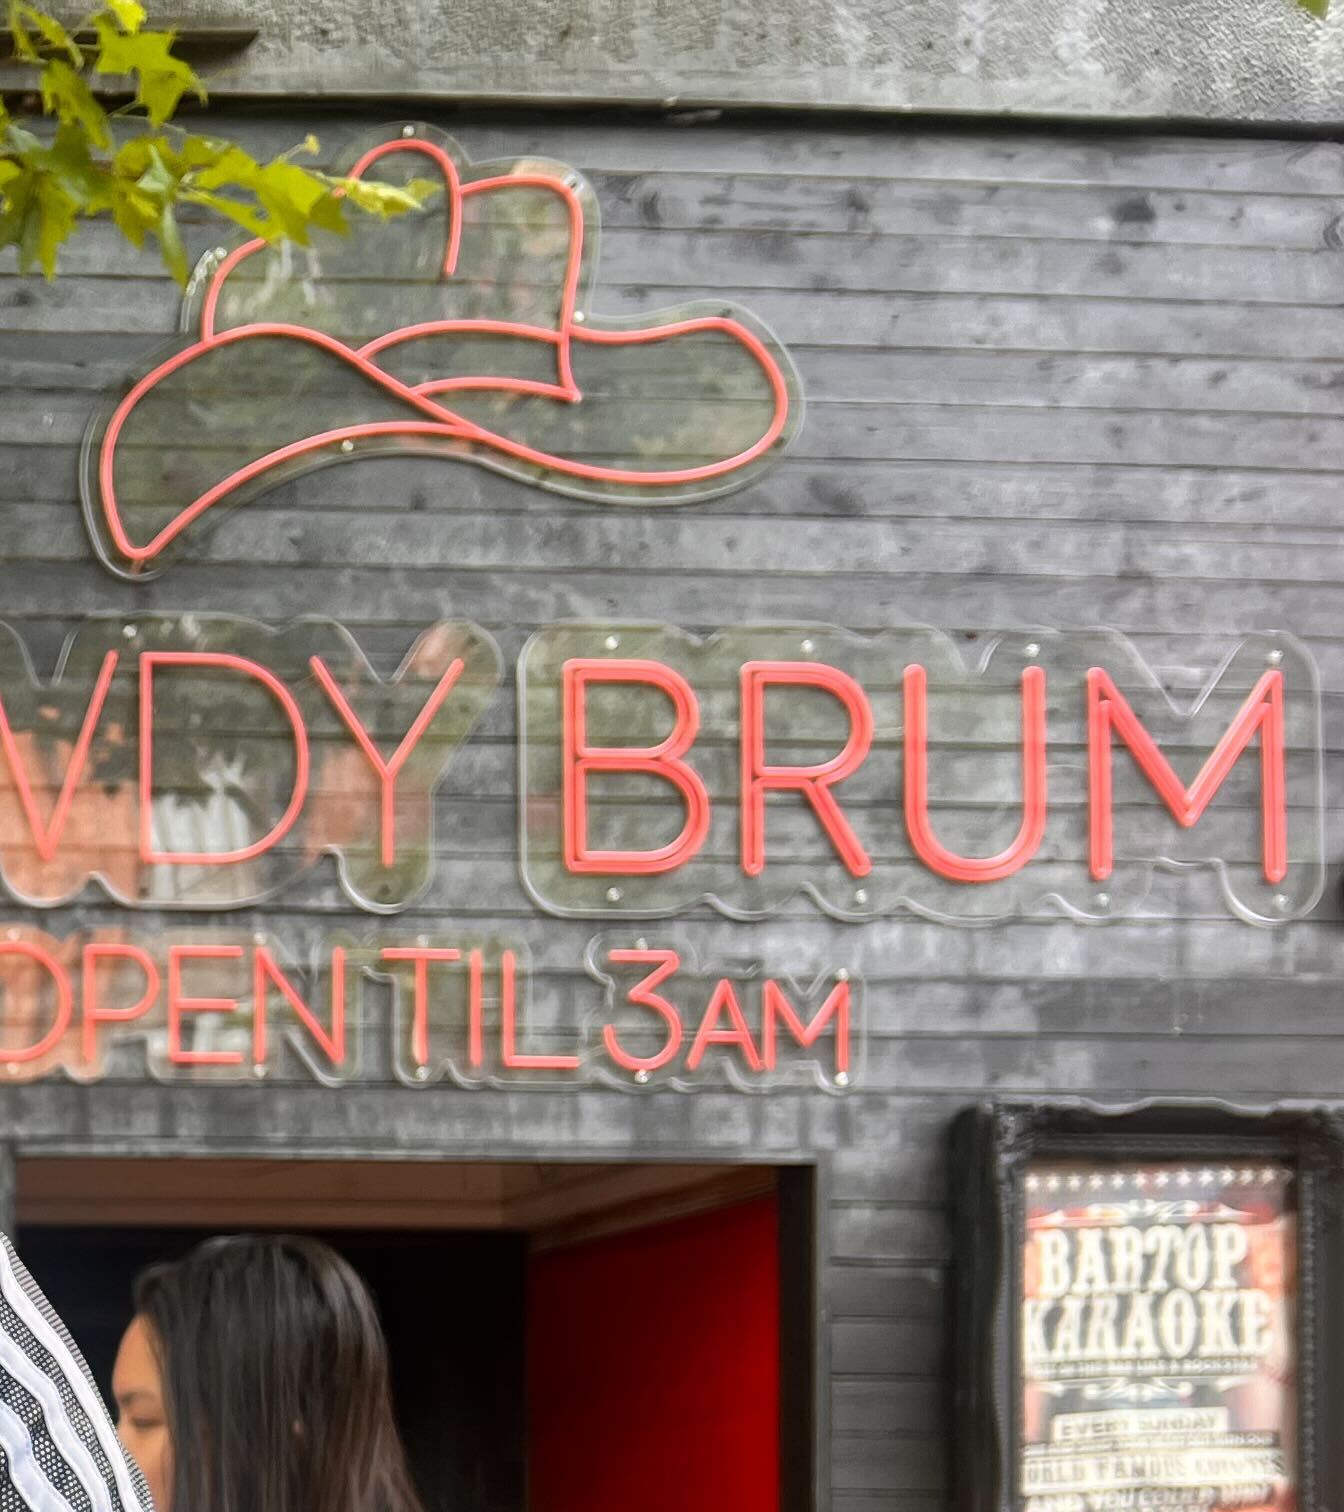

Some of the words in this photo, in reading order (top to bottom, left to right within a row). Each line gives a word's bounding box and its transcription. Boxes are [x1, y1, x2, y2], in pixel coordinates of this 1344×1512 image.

[558, 656, 1286, 885] BRUM
[379, 945, 579, 1070] TIL
[603, 947, 852, 1072] 3AM
[1034, 1222, 1249, 1296] BARTOP
[1024, 1287, 1275, 1360] KARAOKE
[1025, 1456, 1086, 1484] ORLD
